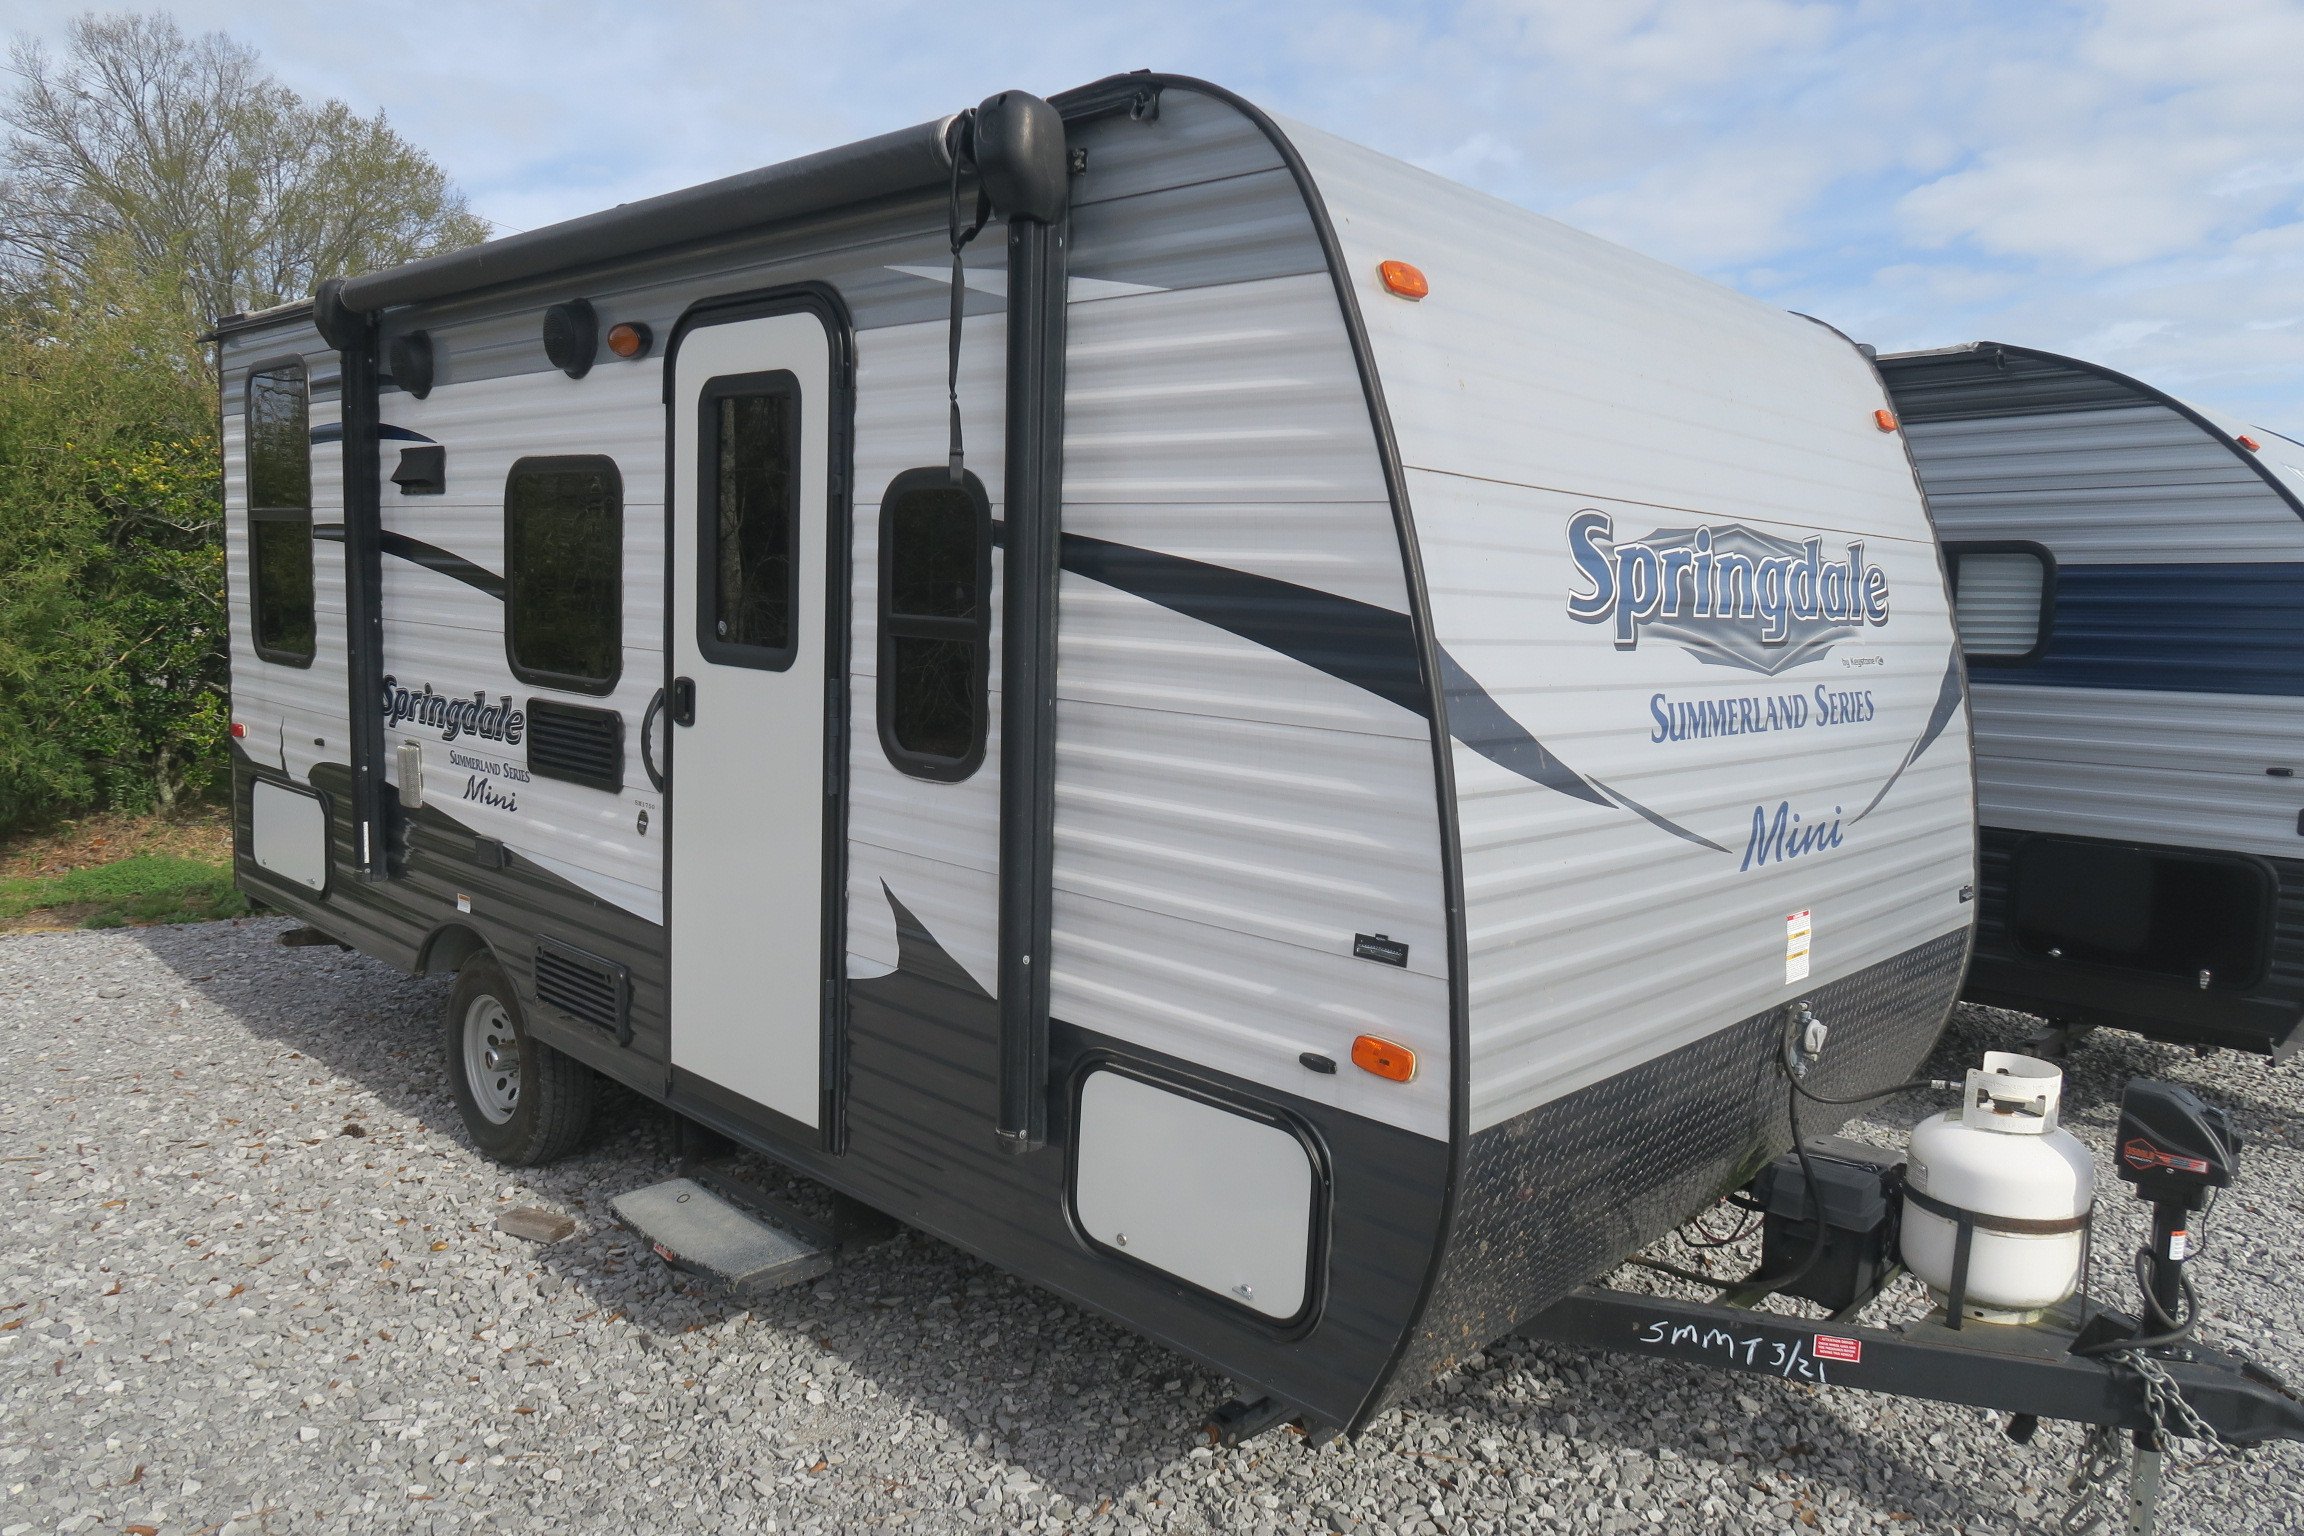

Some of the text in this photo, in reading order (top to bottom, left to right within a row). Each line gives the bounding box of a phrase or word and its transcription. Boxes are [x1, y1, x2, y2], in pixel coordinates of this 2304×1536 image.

[1565, 508, 1889, 651] Springdale
[383, 674, 526, 745] Springdale
[1650, 684, 1875, 743] SUMMERLAND SERIES
[449, 749, 531, 783] SUMMERLAND SERIES
[463, 774, 518, 812] Mini
[1739, 800, 1844, 872] Mini
[1769, 1338, 1826, 1383] 3/21
